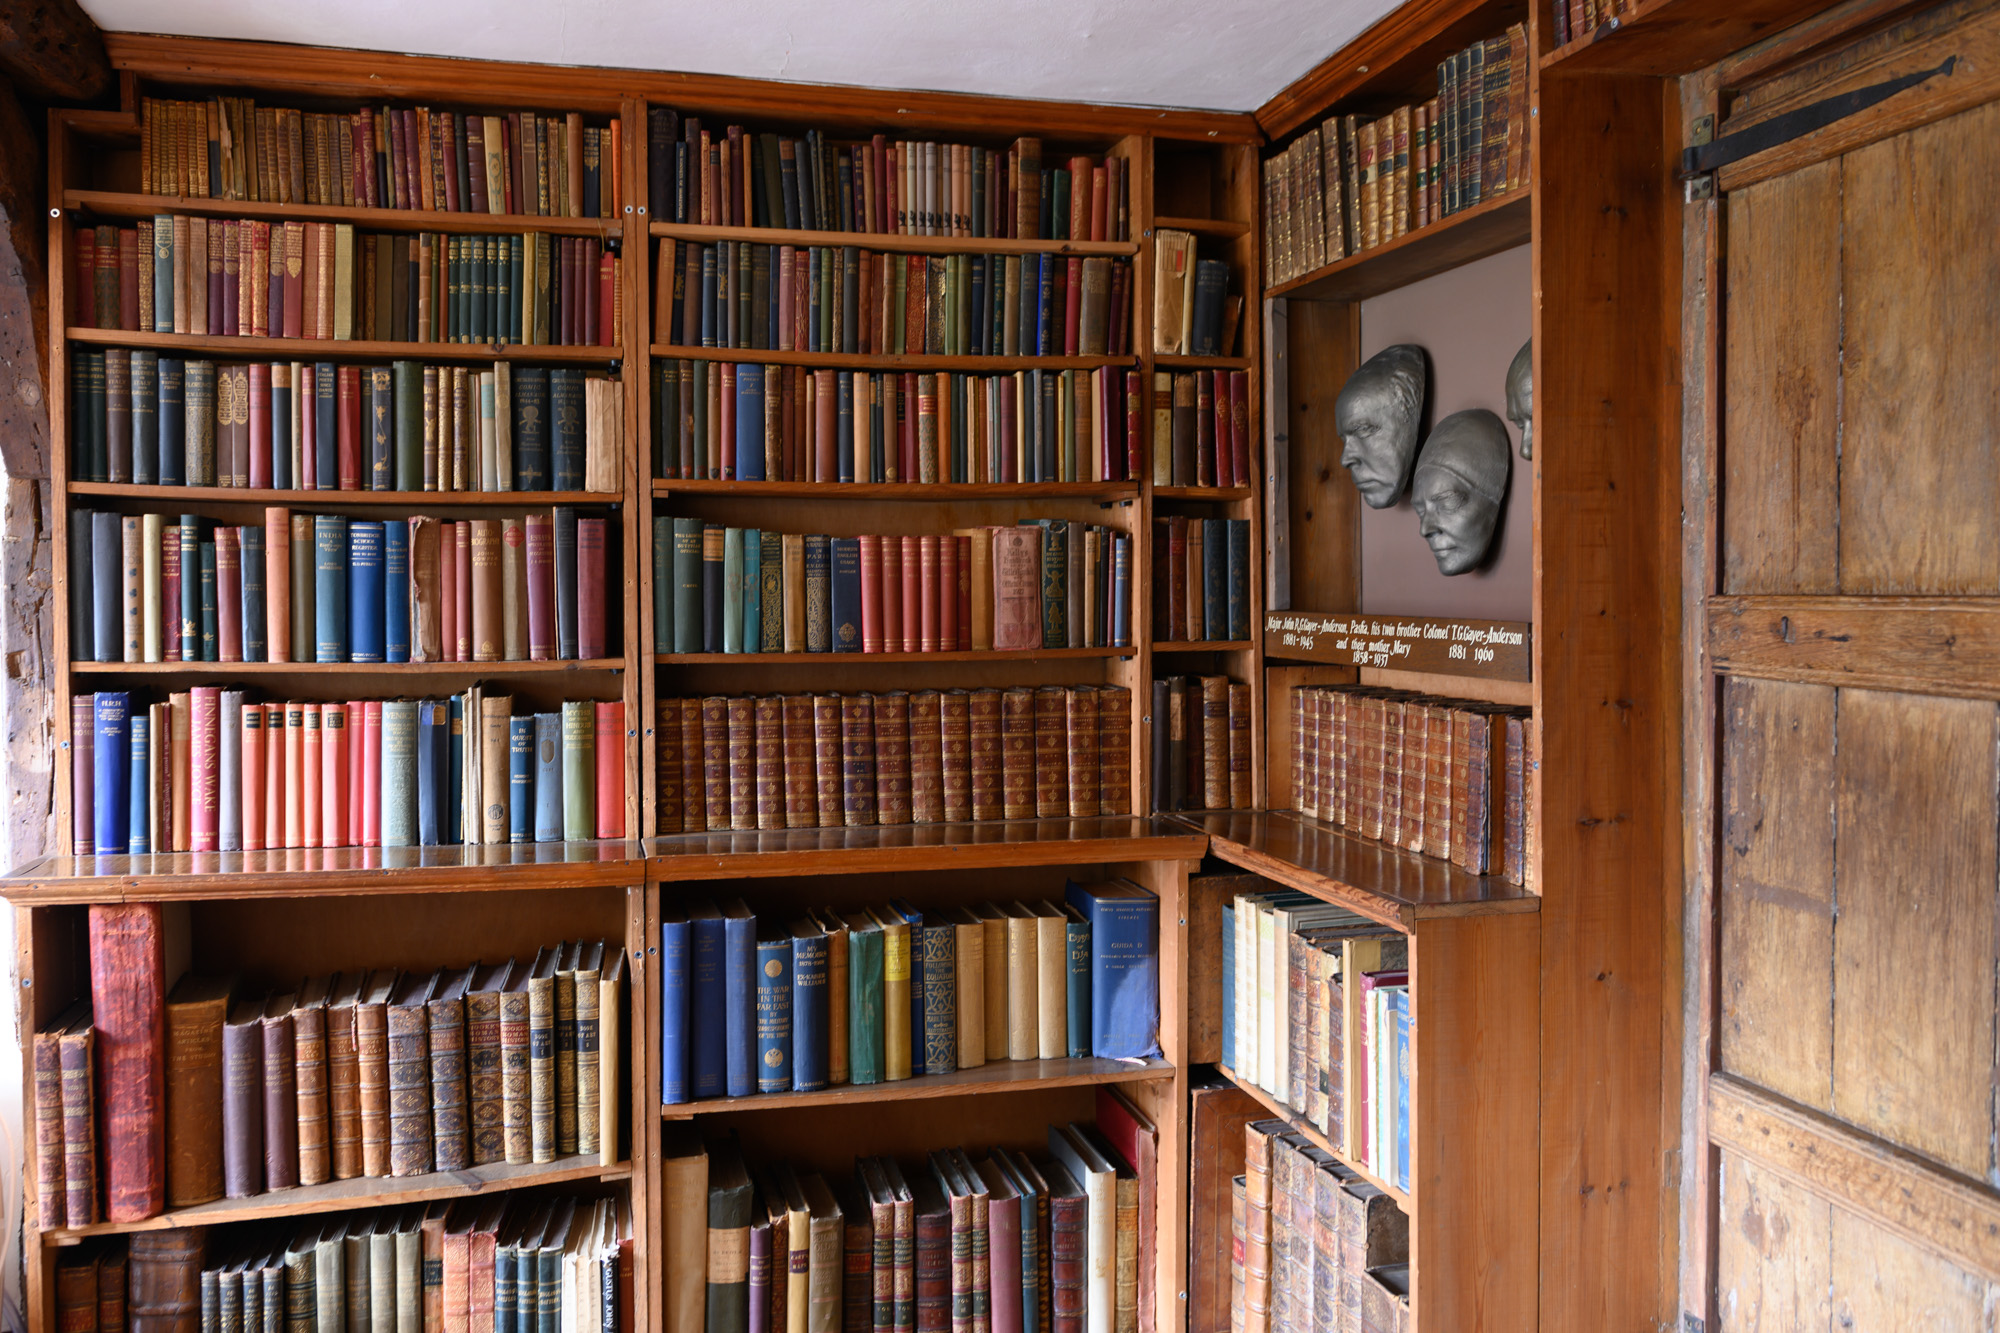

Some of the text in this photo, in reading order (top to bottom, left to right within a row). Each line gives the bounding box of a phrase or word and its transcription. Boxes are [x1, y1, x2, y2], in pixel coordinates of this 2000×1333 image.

[1265, 615, 1282, 632] Major
[1282, 616, 1295, 630] John
[1349, 619, 1370, 635] Pasha,
[1370, 621, 1381, 636] his
[1381, 623, 1395, 636] twin
[1396, 622, 1422, 638] brother
[1423, 623, 1451, 639] Colonel
[1336, 637, 1411, 659] and their mother Mary
[1448, 644, 1494, 665] 1881 1960
[385, 711, 415, 720] VENICE
[191, 696, 202, 805] BY JAMES JOYCE
[204, 696, 216, 813] FINNEGANS WAKE
[796, 951, 827, 959] MEMOIRS
[772, 985, 789, 993] WAR
[757, 1002, 789, 1011] FAR EAST
[605, 1304, 614, 1328] JOHN
